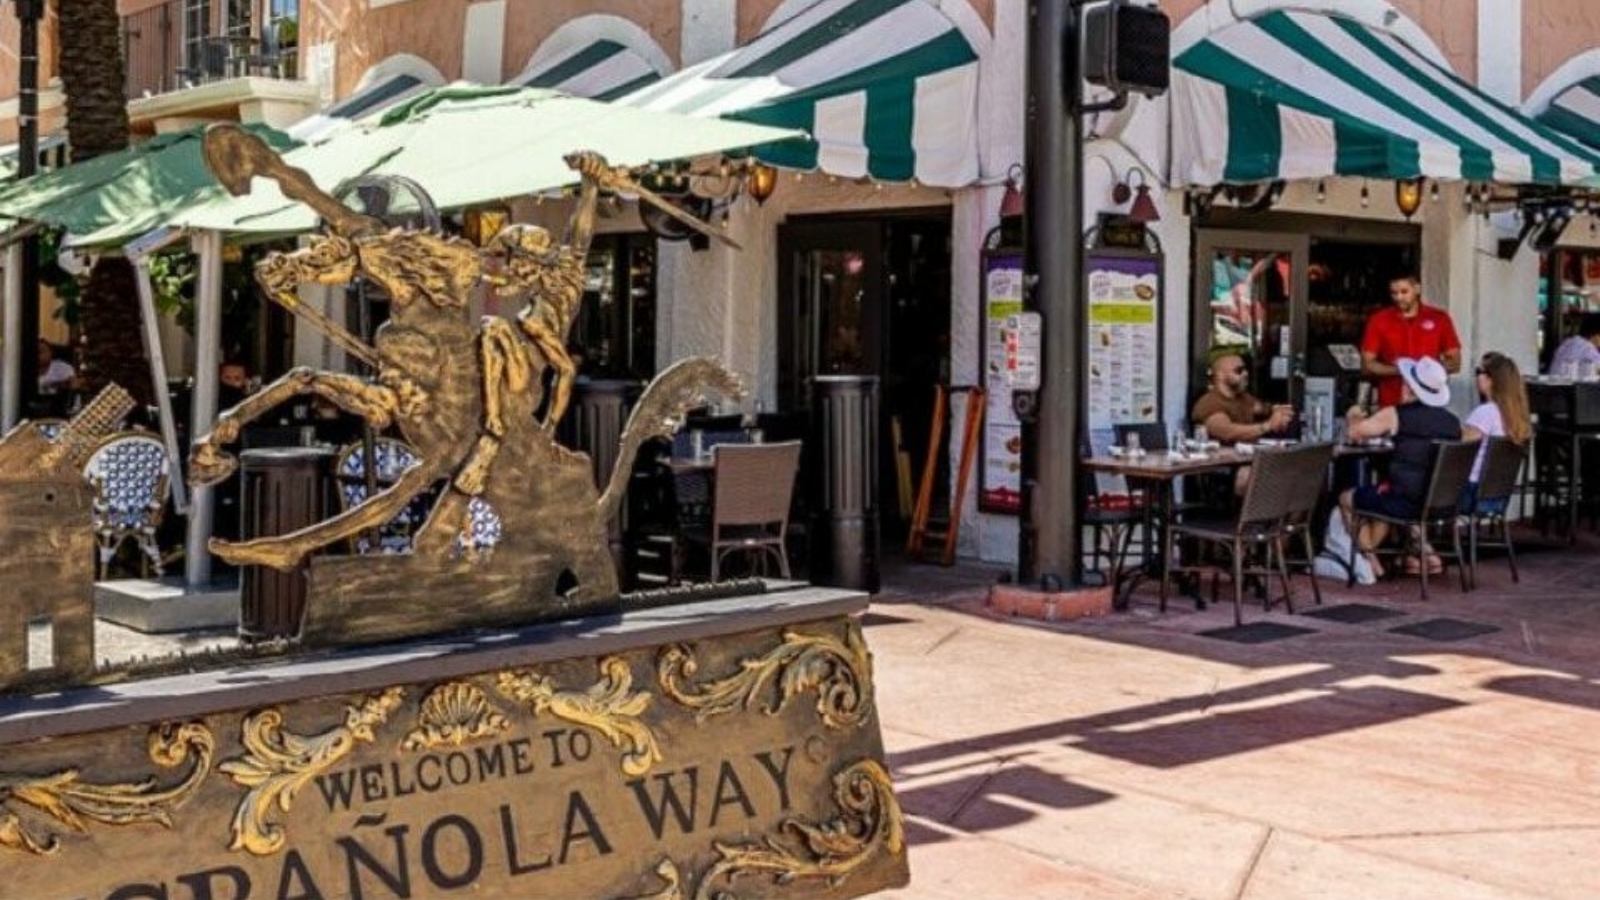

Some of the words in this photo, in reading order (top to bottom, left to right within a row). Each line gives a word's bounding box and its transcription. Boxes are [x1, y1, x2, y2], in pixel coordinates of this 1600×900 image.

[315, 738, 534, 812] WELCOME
[543, 729, 592, 768] TO
[626, 747, 795, 840] WAY
